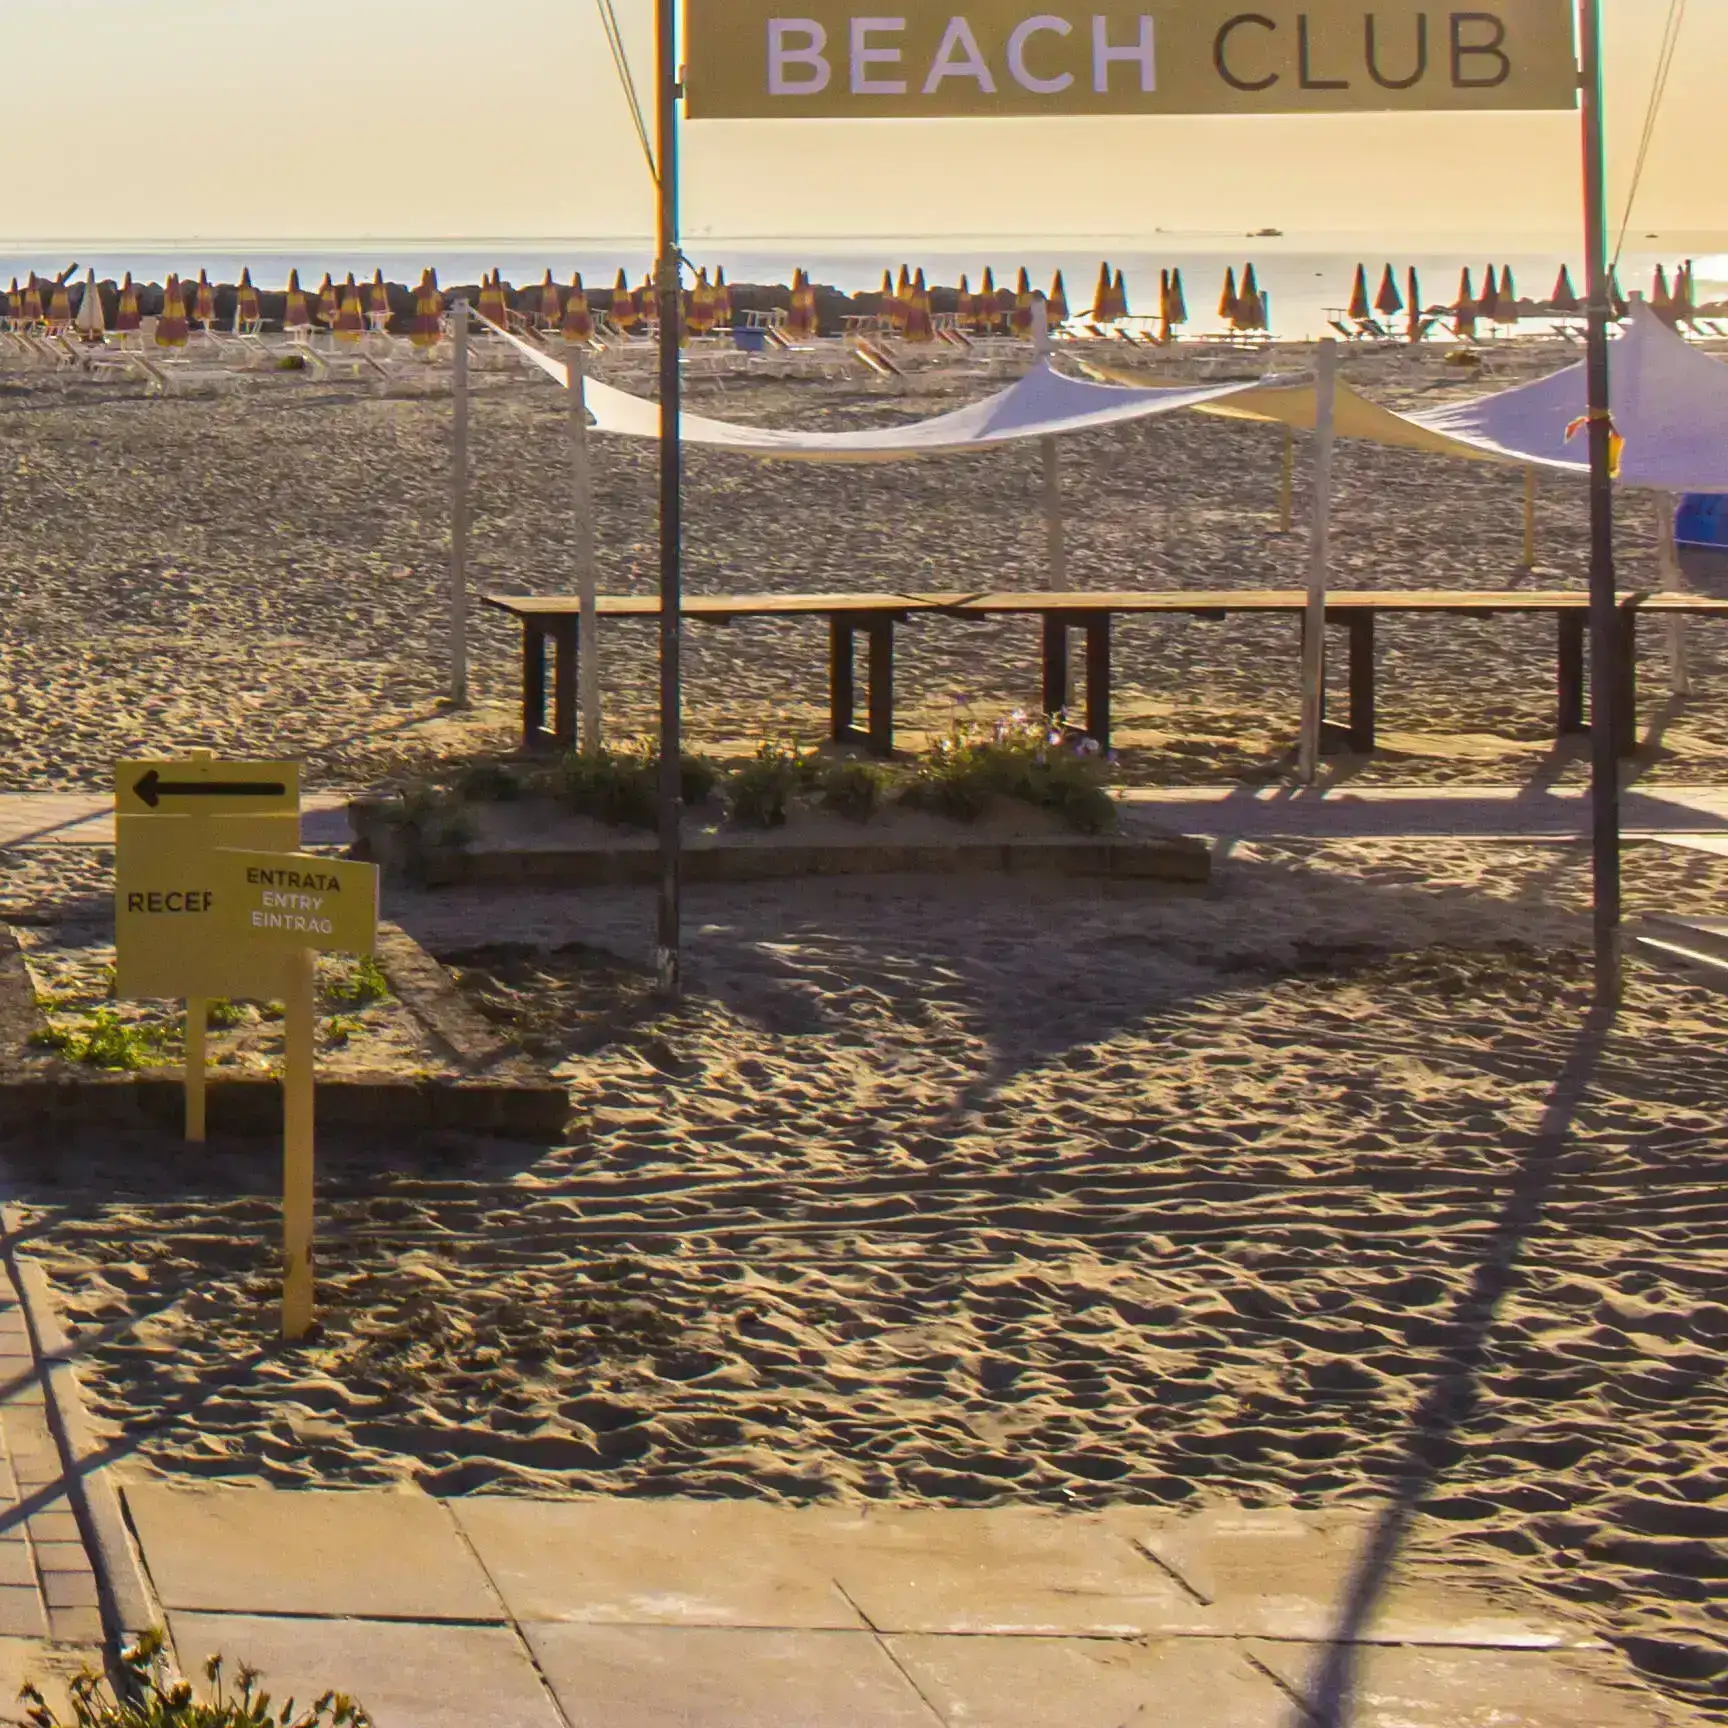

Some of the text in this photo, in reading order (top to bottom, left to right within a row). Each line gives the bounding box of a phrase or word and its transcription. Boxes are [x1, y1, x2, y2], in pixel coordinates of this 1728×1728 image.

[768, 12, 1511, 94] BEACH CLUB
[247, 867, 341, 892] ENTRATA
[262, 891, 323, 910] ENTRY
